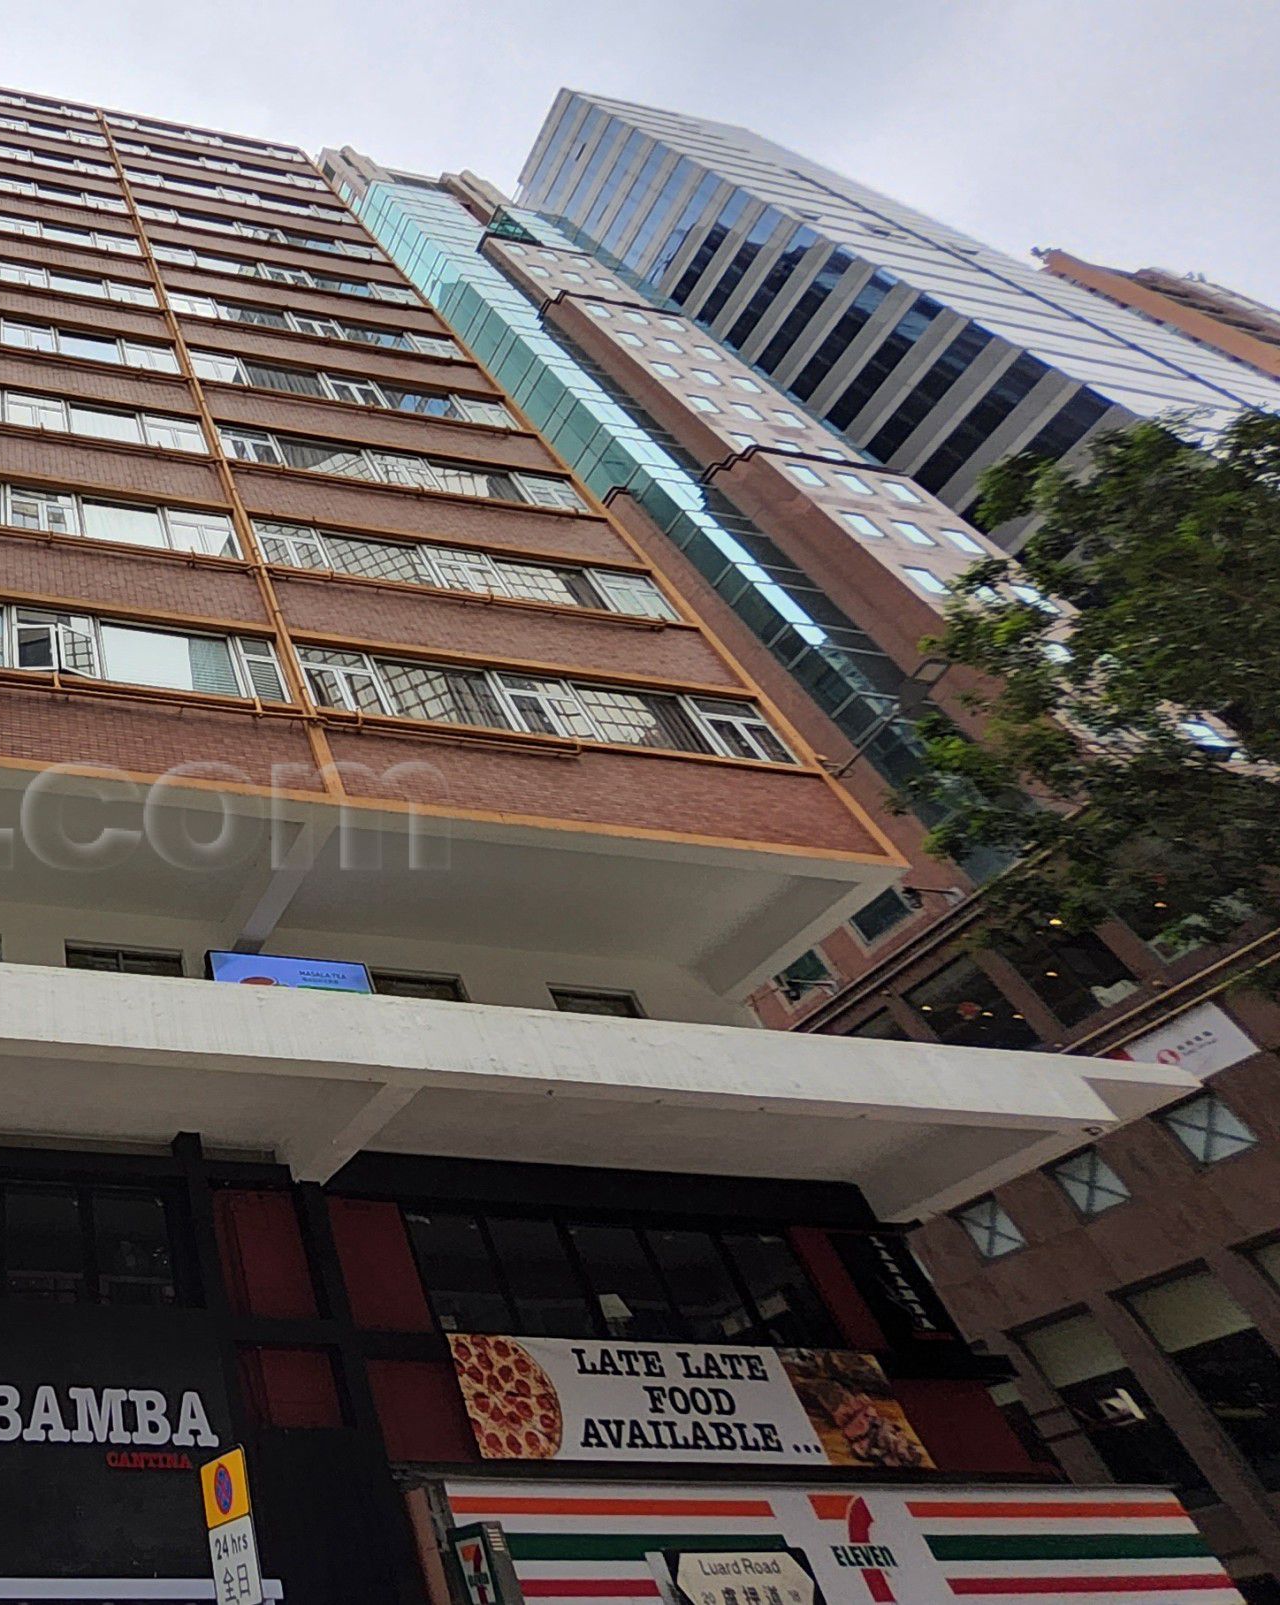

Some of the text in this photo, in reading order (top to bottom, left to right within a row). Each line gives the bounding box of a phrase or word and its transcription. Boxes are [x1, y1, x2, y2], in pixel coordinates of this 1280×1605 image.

[571, 1348, 769, 1382] LATE LATE
[642, 1385, 737, 1417] FOOD
[579, 1417, 785, 1453] AVAILABLE
[214, 1533, 249, 1561] 24 hrs
[222, 1562, 251, 1602] 全日
[698, 1557, 782, 1577] Luard Road
